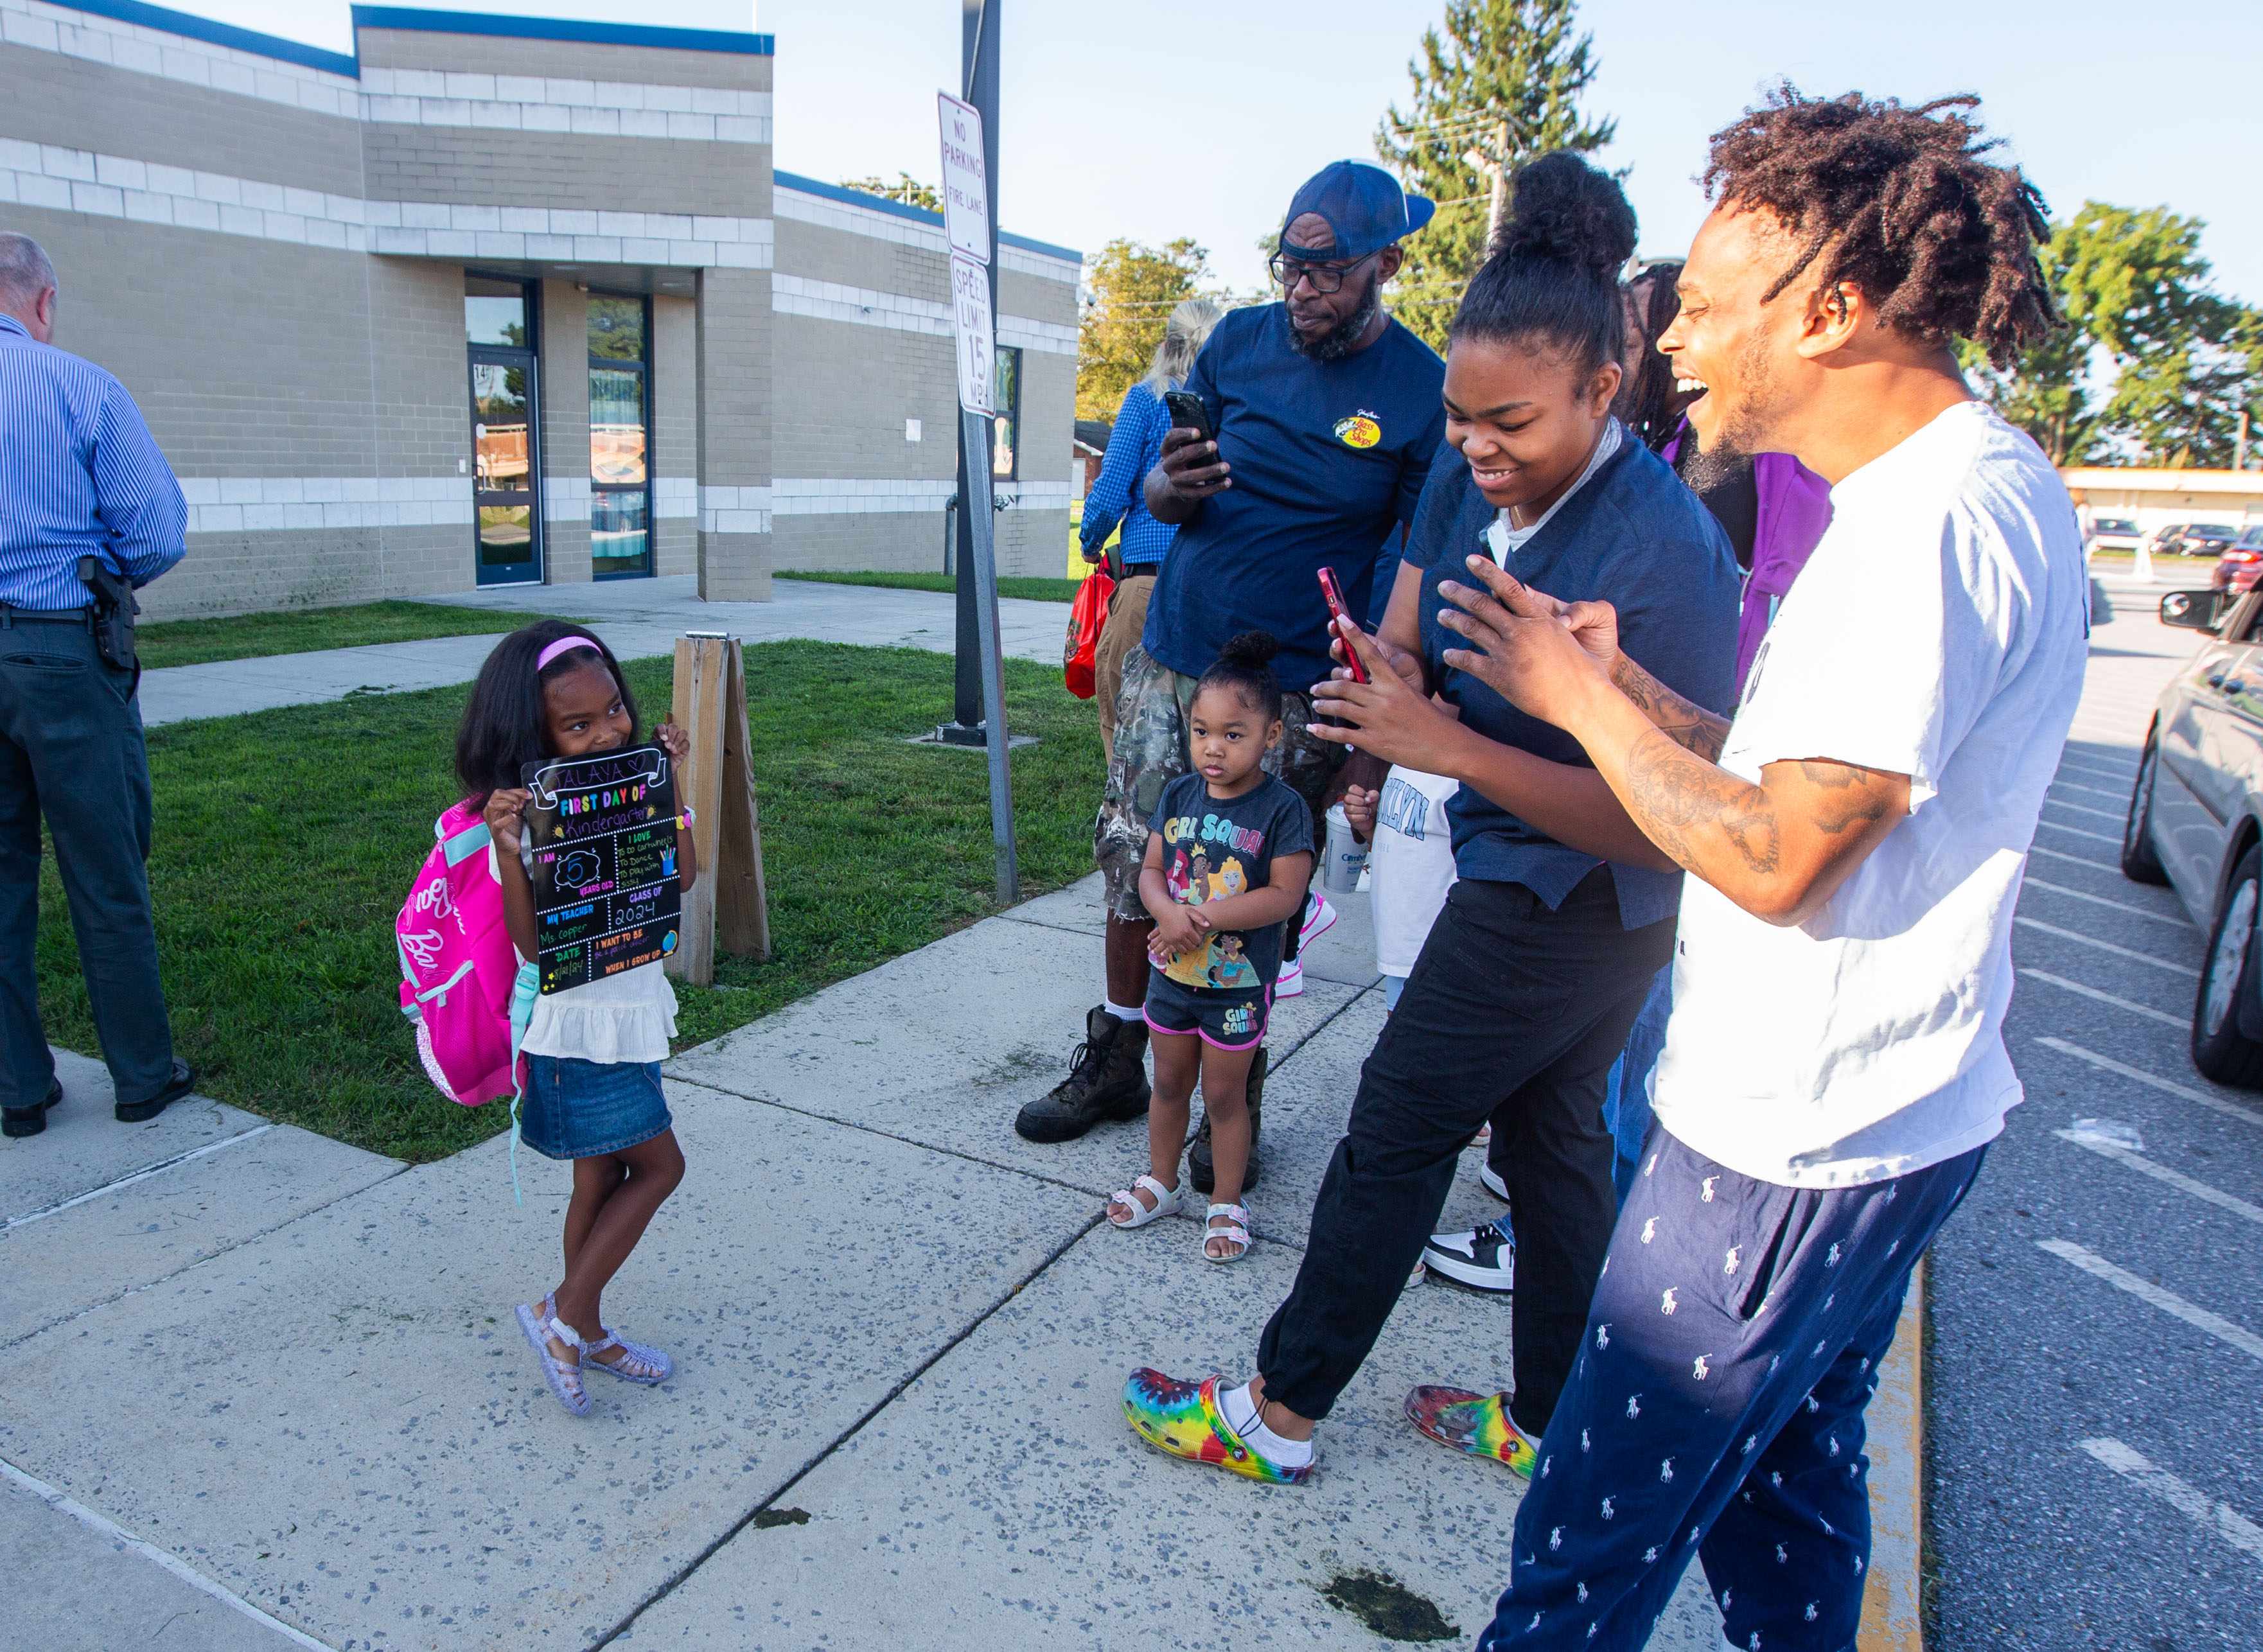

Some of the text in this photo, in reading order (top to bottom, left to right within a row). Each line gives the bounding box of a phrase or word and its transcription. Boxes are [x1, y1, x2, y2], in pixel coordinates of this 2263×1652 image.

[954, 118, 966, 142] NO
[944, 141, 982, 178] PARKING
[949, 186, 983, 216] FIRE LANE
[956, 268, 986, 304] SPEED
[961, 301, 986, 335] LIMIT
[969, 334, 986, 380] 15
[475, 365, 485, 379] 14
[971, 382, 989, 407] MPH
[1356, 419, 1373, 430] Bass
[1349, 433, 1372, 446] Shops
[560, 784, 646, 816] FIRST DAY OF
[566, 807, 649, 838] Kindergarten
[629, 830, 651, 843] I LOVE
[538, 852, 556, 864] I AM
[567, 857, 583, 881] 5
[579, 881, 614, 898] YEARS OLD
[630, 886, 662, 904] CLASS OF
[547, 904, 594, 926] MY TEACHER
[615, 901, 655, 925] 2024
[595, 928, 643, 950] I WANT TO BE
[555, 947, 581, 962] DATE
[605, 949, 661, 974] WHEN I GROW UP
[1222, 1019, 1258, 1035] SQUAD
[1225, 1008, 1255, 1023] GIRL
